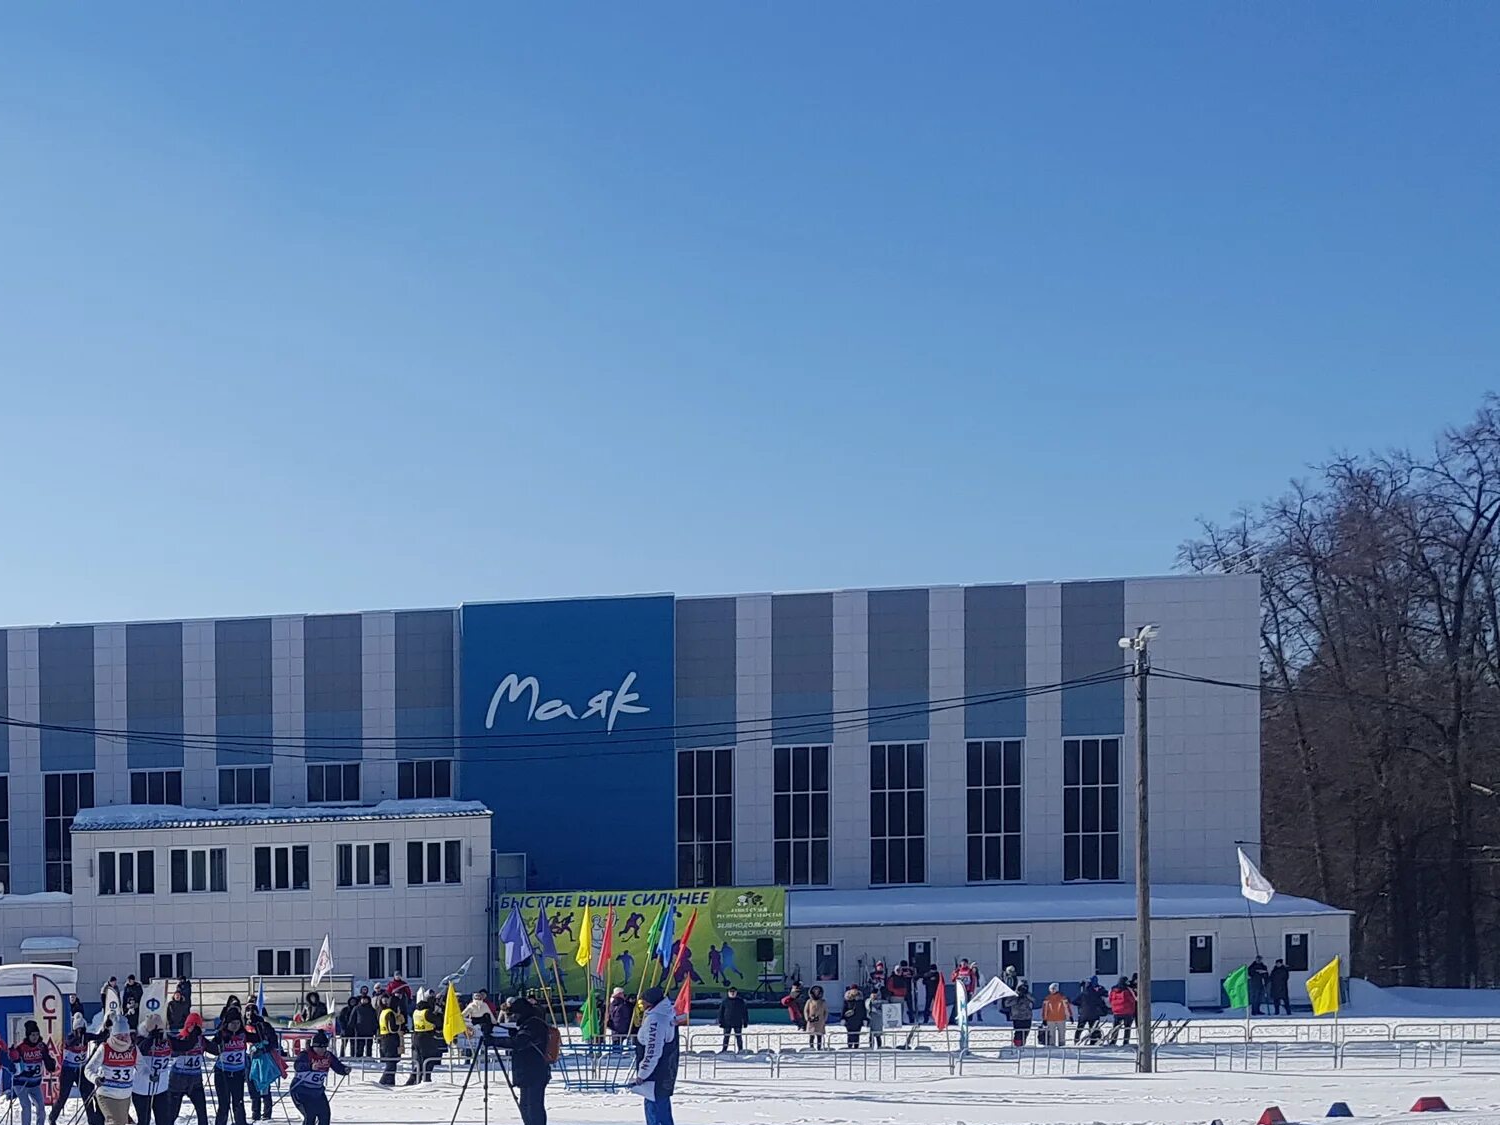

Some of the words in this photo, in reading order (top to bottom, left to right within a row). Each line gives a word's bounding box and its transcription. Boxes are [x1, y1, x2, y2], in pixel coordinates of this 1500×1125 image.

[485, 671, 650, 735] Маяк
[500, 895, 572, 909] БЫСТРЕЕ
[577, 892, 627, 907] ВЫШЕ
[631, 891, 710, 906] СИЛЬНЕЕ
[724, 928, 767, 937] ГОРОДСКОЙ
[42, 994, 59, 1095] СТАТ
[641, 1021, 658, 1071] TATARSTAN
[108, 1051, 134, 1060] МАЯК
[226, 1052, 243, 1063] 62
[112, 1069, 131, 1081] 33
